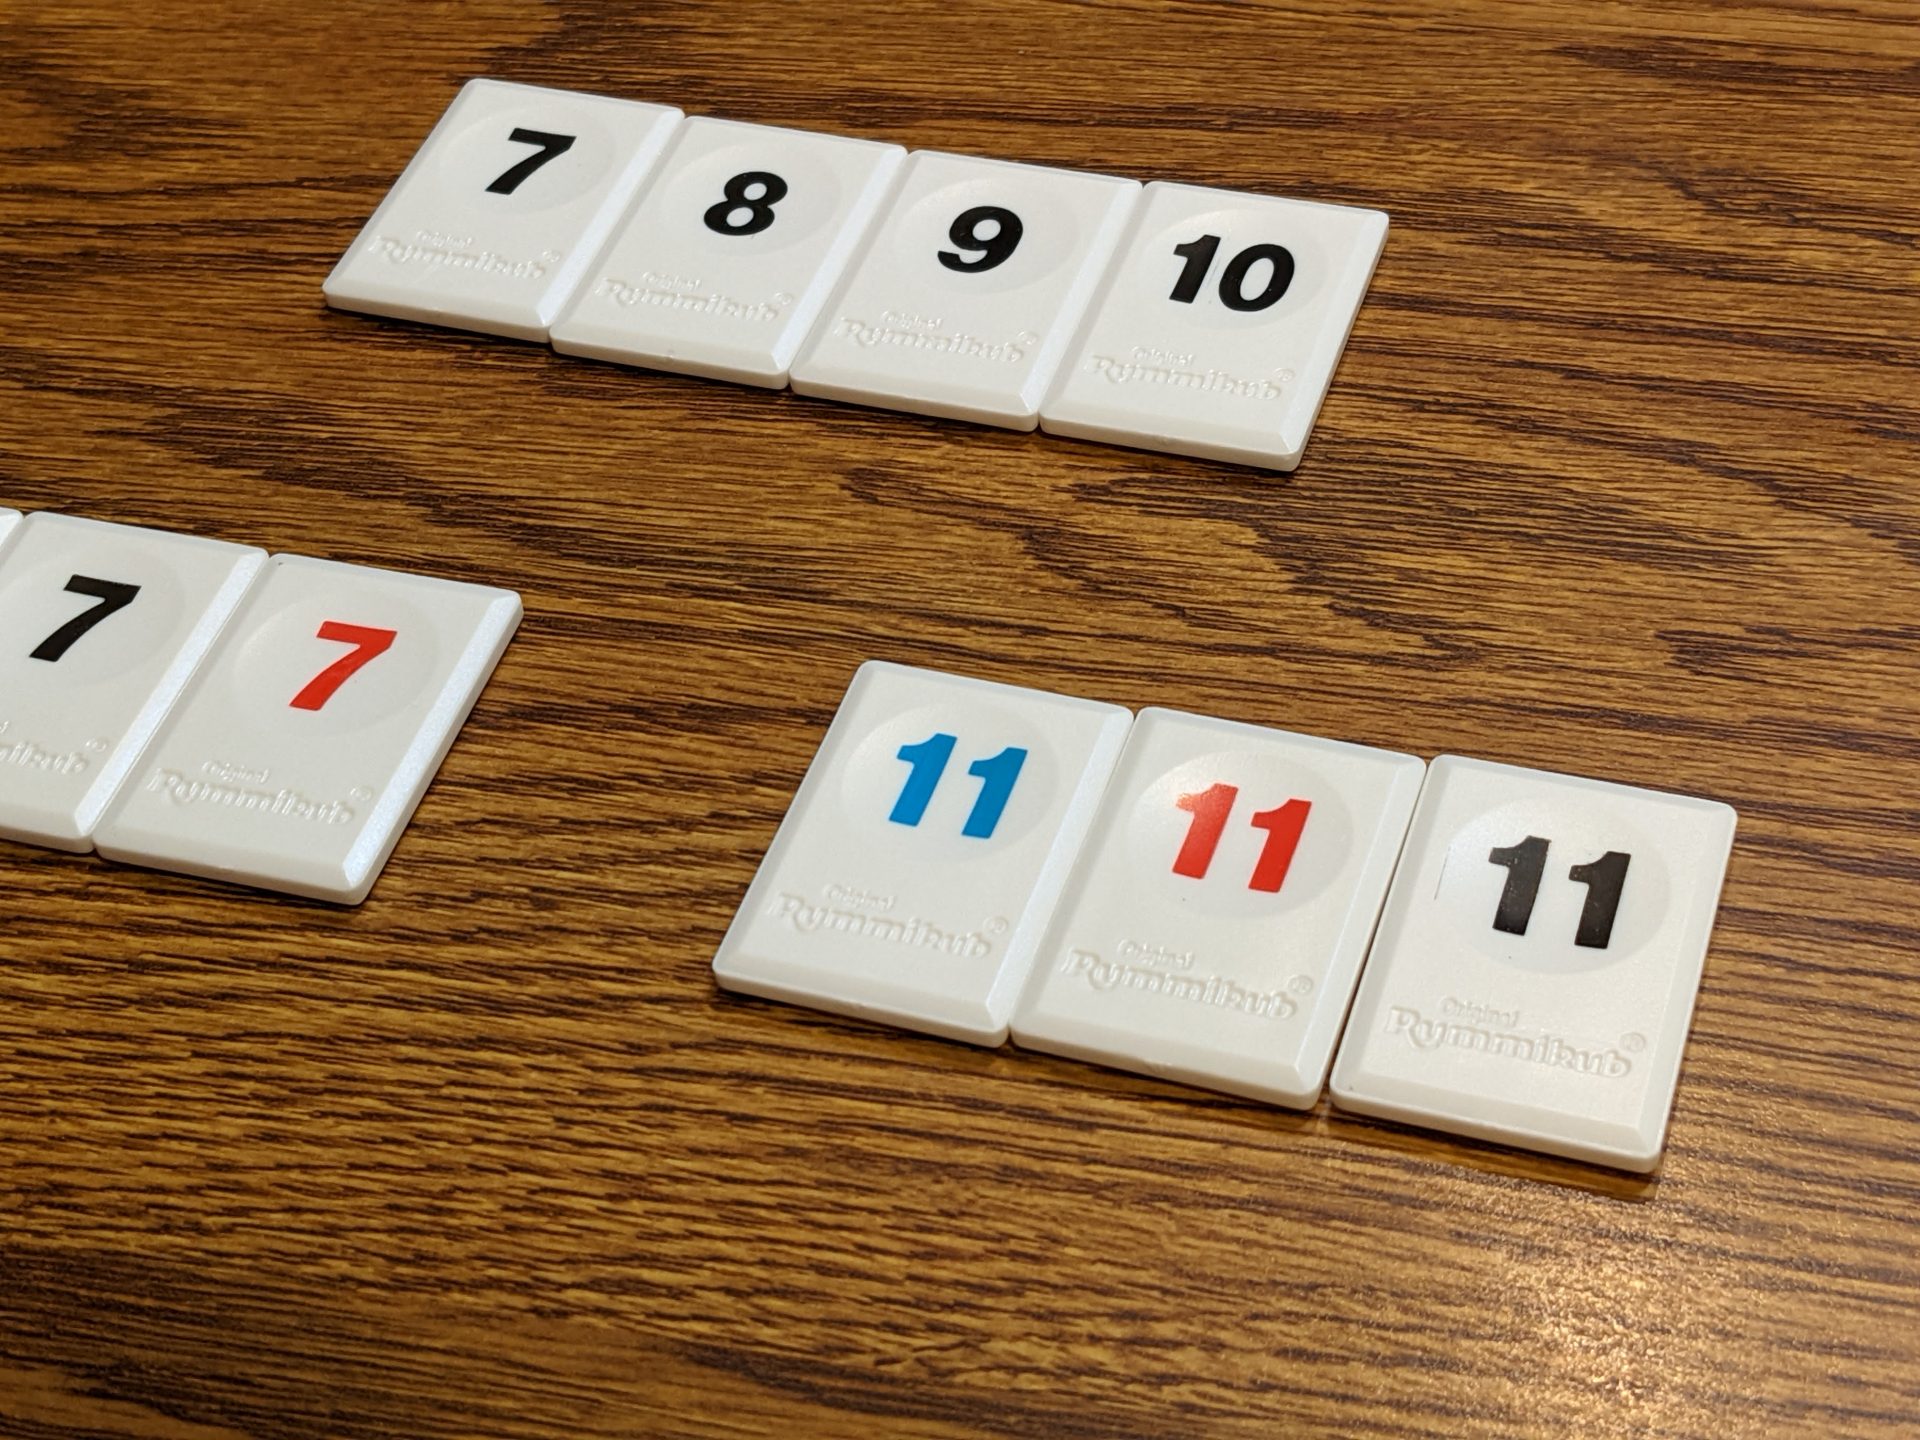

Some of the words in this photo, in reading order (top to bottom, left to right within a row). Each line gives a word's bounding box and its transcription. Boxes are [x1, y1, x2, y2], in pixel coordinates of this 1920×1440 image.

[485, 127, 577, 195] 7
[703, 171, 788, 236] 8
[937, 205, 1024, 274] 9
[1169, 234, 1295, 312] 10
[29, 574, 142, 663] 7
[289, 620, 398, 711] 7
[888, 733, 1028, 839] 11
[1172, 784, 1312, 893] 11
[1488, 836, 1632, 950] 11
